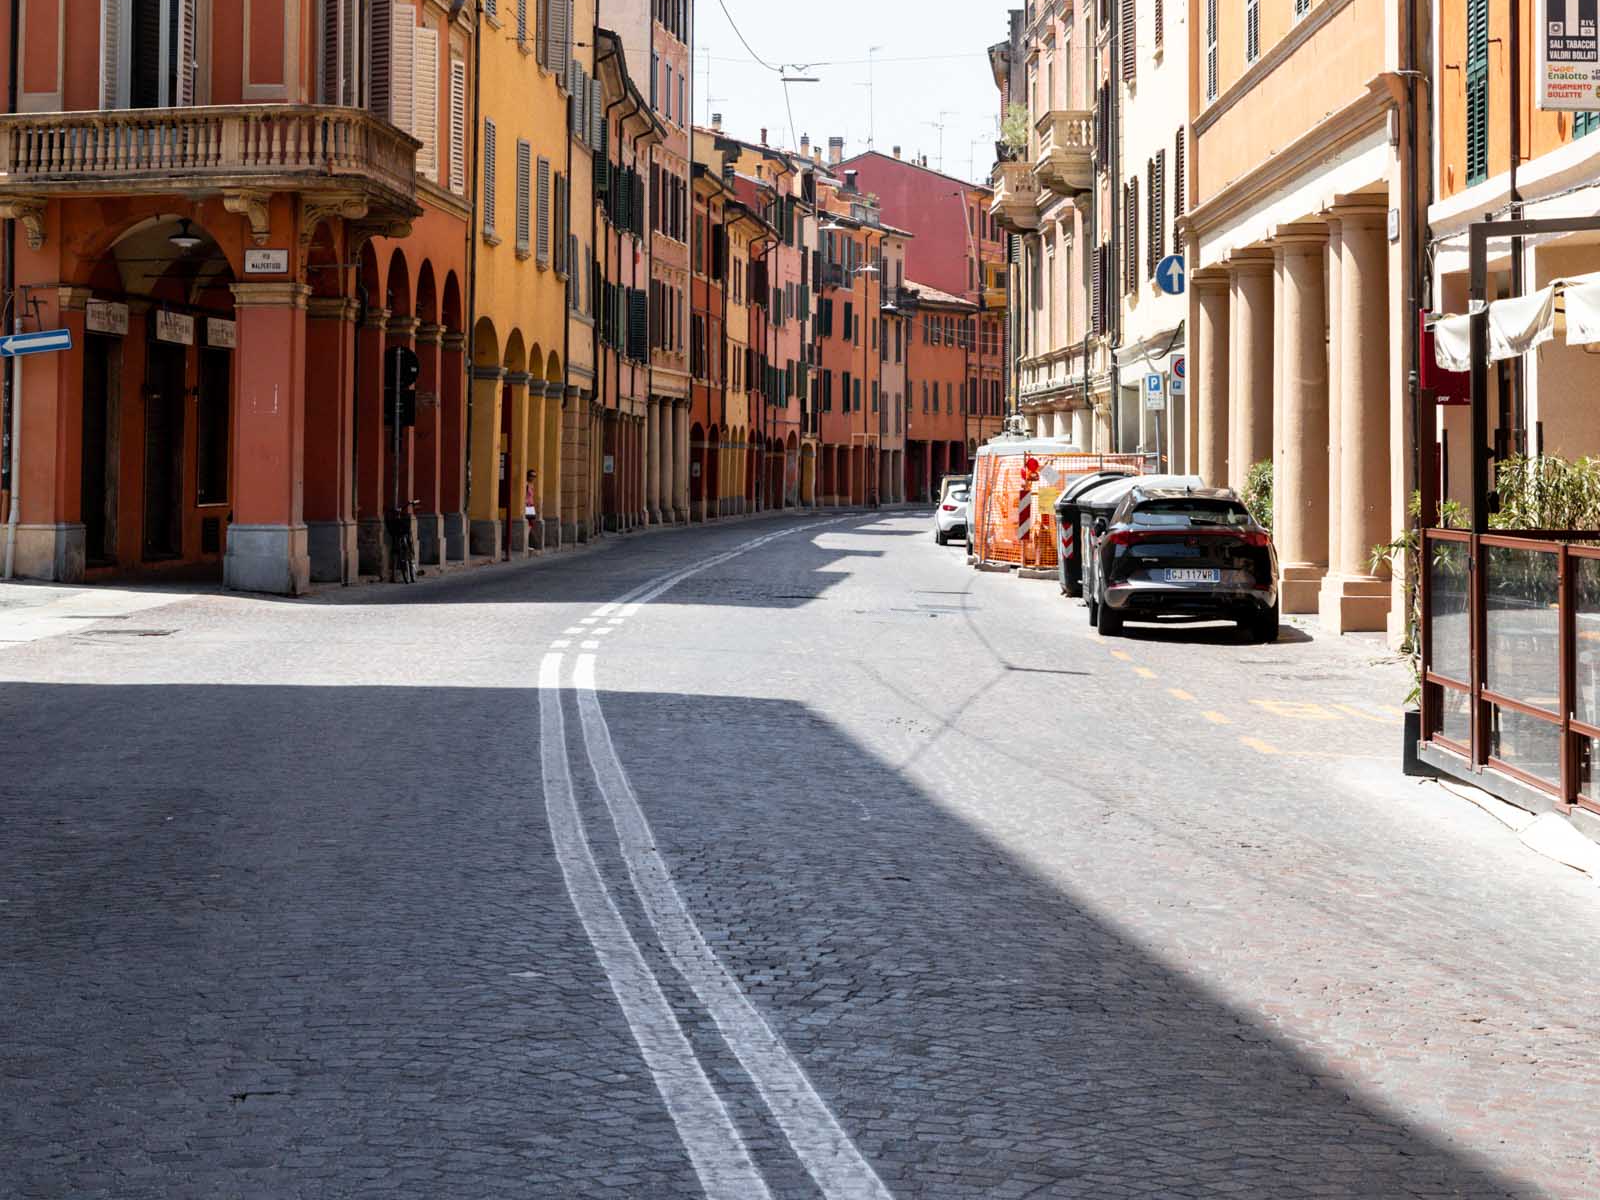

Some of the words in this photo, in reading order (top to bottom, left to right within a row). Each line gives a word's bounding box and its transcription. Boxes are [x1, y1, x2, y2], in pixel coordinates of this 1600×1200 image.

[1581, 19, 1595, 27] RIV.
[1549, 39, 1563, 49] SALI
[1565, 40, 1596, 49] TABACCHI
[1549, 50, 1571, 60] VALORI
[1572, 50, 1597, 60] BOLLATI
[1548, 72, 1588, 80] Enalotto
[1547, 83, 1592, 91] PAGAMENTO
